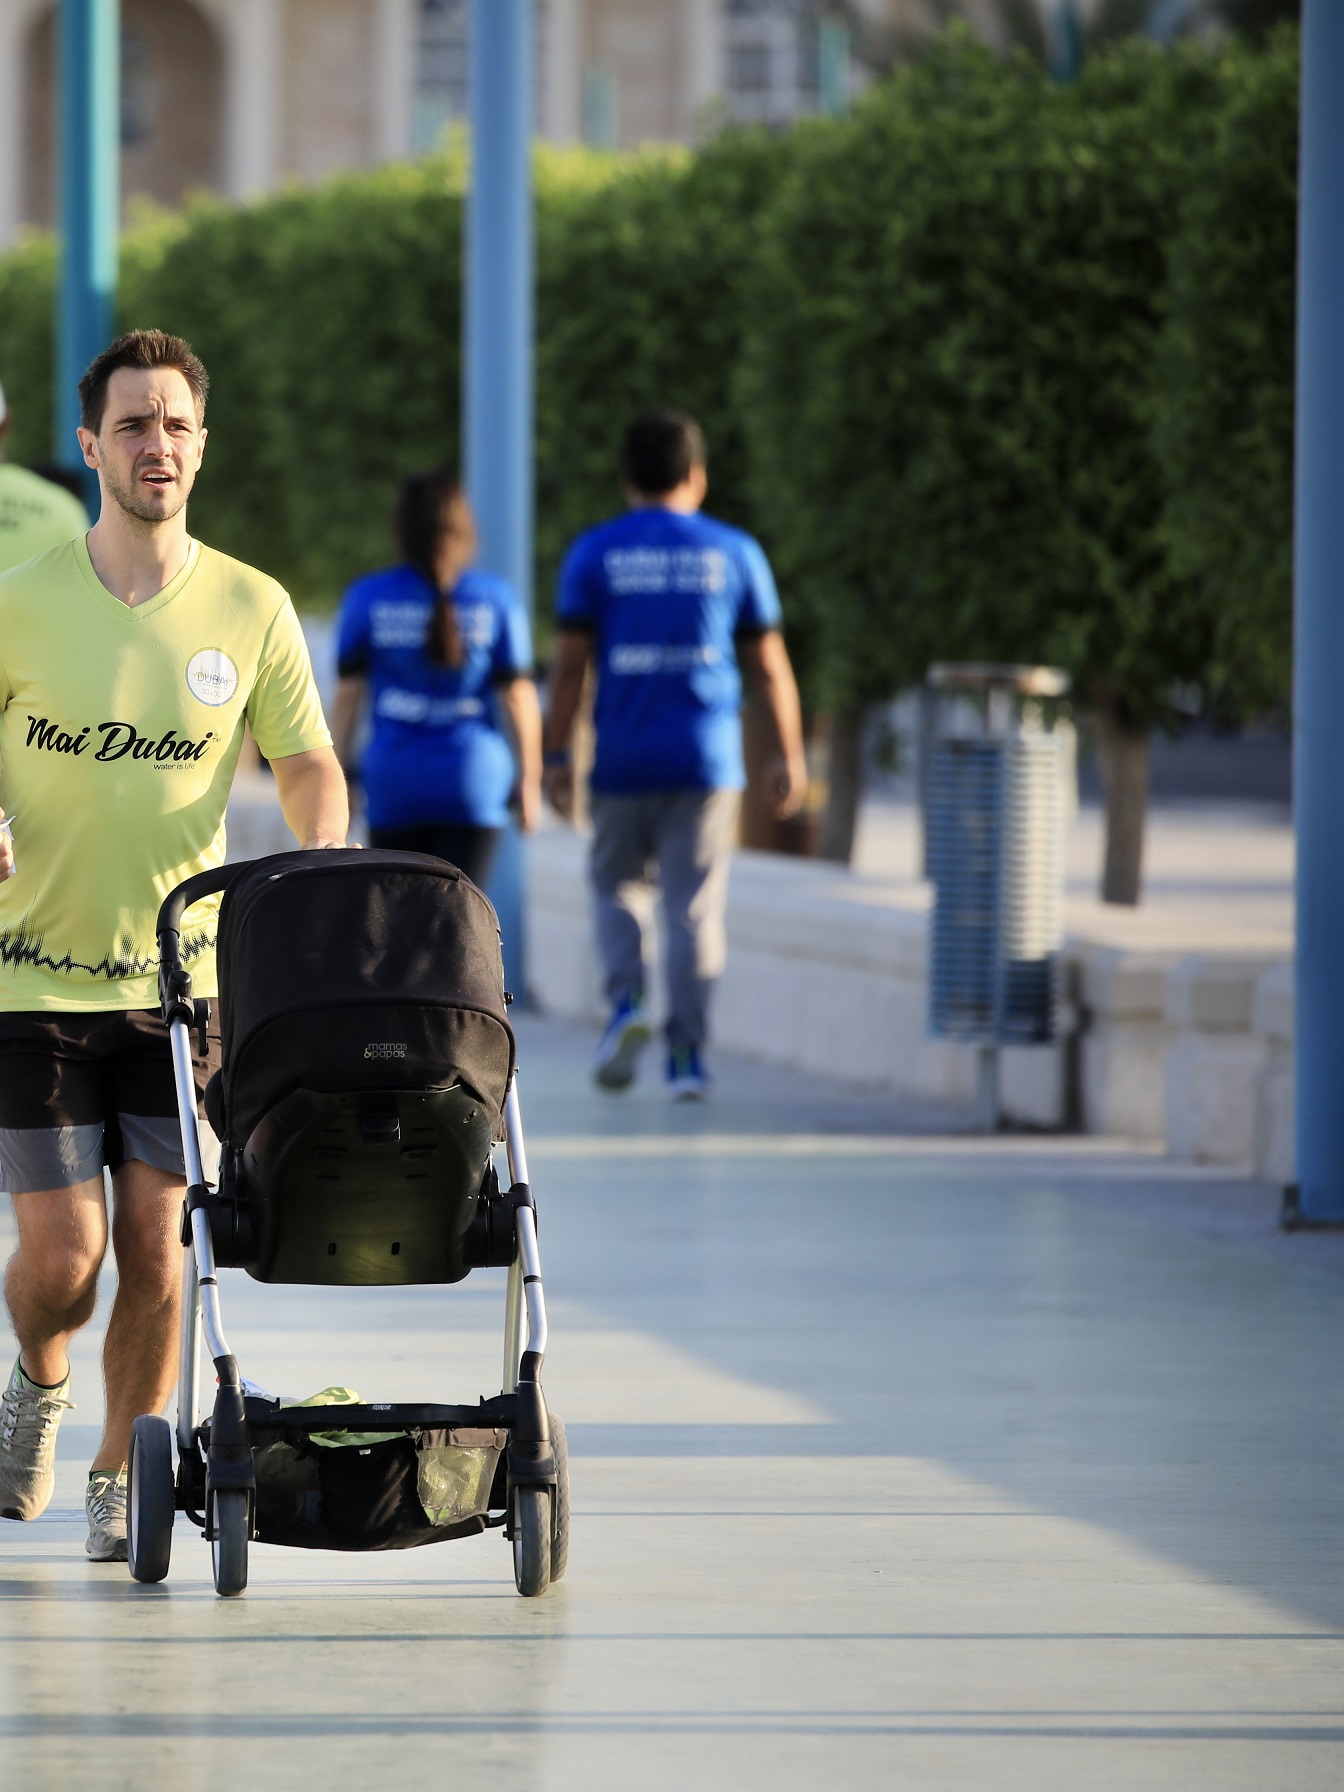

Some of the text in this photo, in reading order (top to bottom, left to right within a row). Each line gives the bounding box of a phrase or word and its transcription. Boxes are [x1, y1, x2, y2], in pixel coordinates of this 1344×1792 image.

[26, 715, 91, 755] Mai
[94, 722, 213, 762] Dubai
[176, 762, 184, 770] is
[185, 762, 196, 770] life
[368, 1042, 408, 1051] mamas
